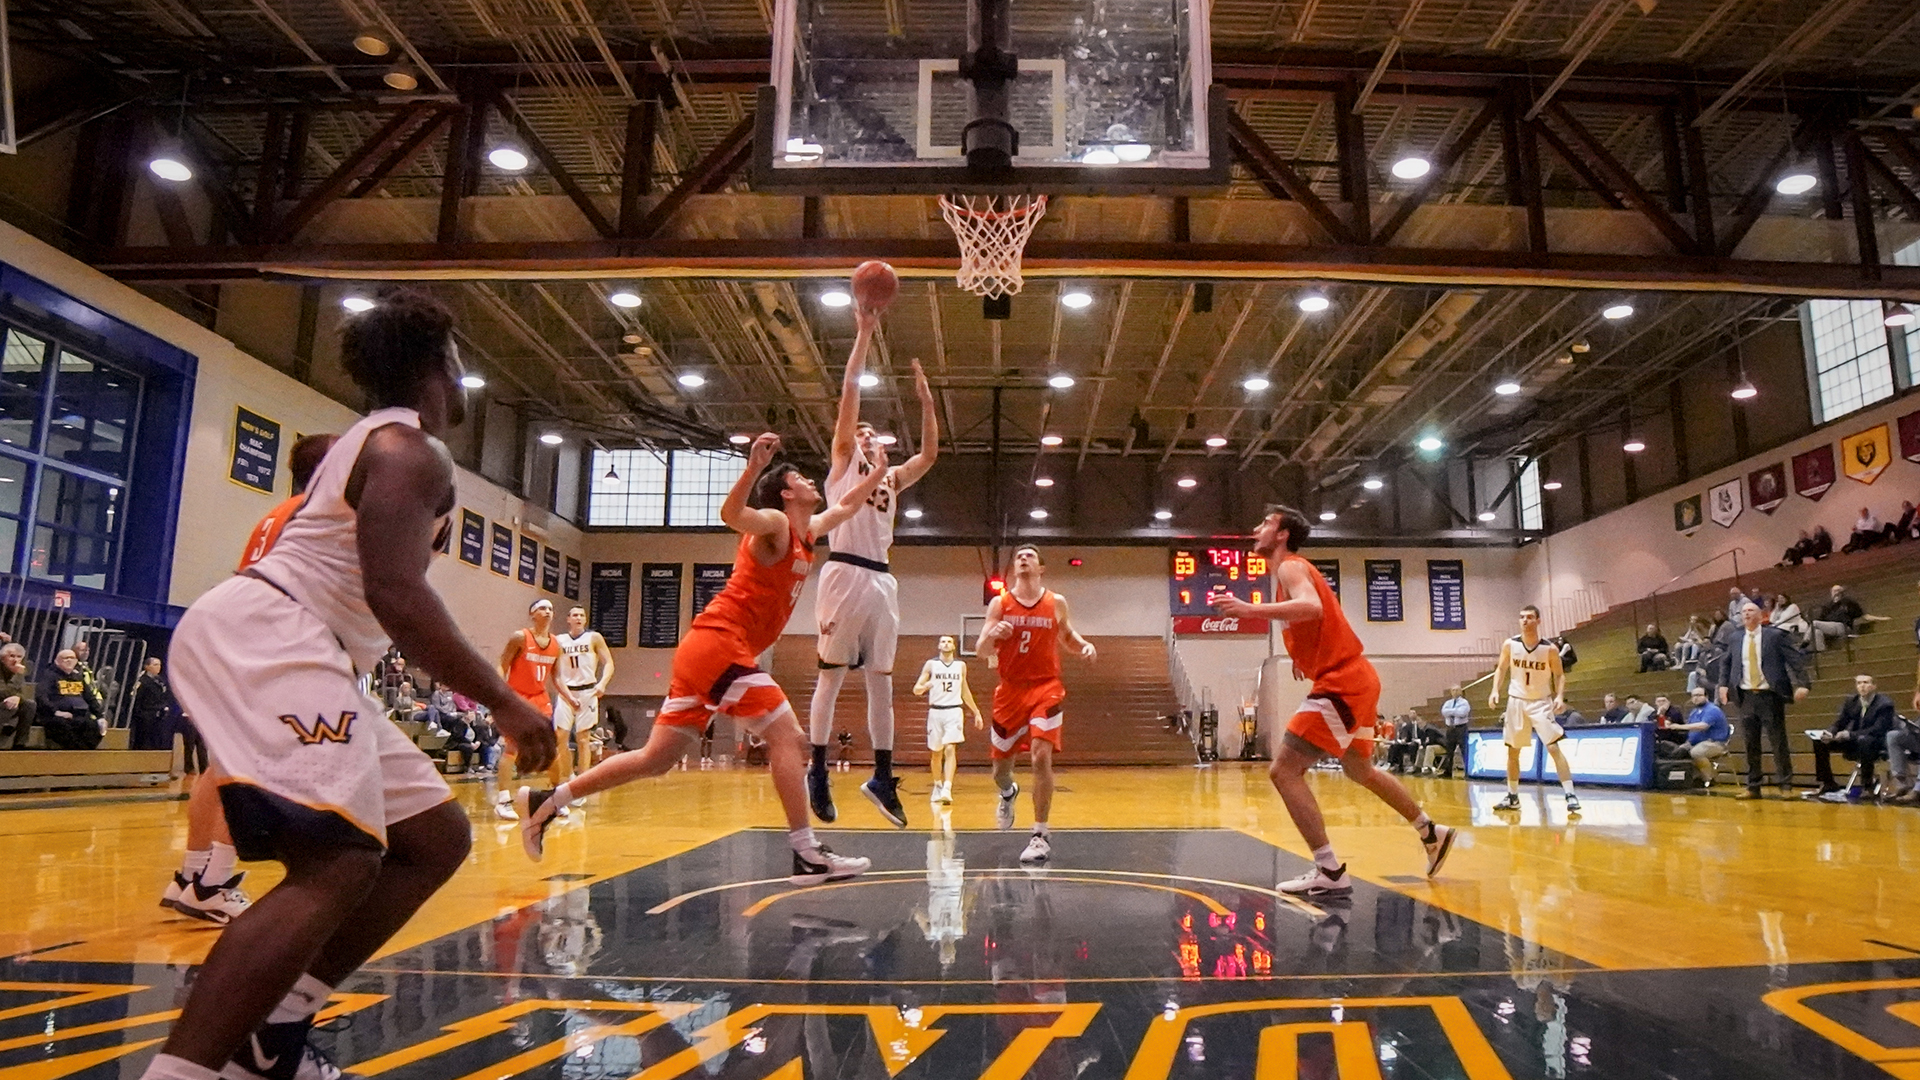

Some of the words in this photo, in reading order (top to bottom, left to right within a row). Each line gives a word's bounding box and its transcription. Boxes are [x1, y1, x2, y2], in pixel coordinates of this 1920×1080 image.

[1175, 557, 1195, 575] 63
[1230, 566, 1239, 580] 2
[1020, 631, 1031, 653] 2
[570, 656, 579, 669] 11
[1513, 659, 1546, 670] WILKES
[536, 665, 547, 681] 11
[1525, 672, 1530, 685] 1
[942, 682, 953, 692] 12
[278, 711, 357, 745] W
